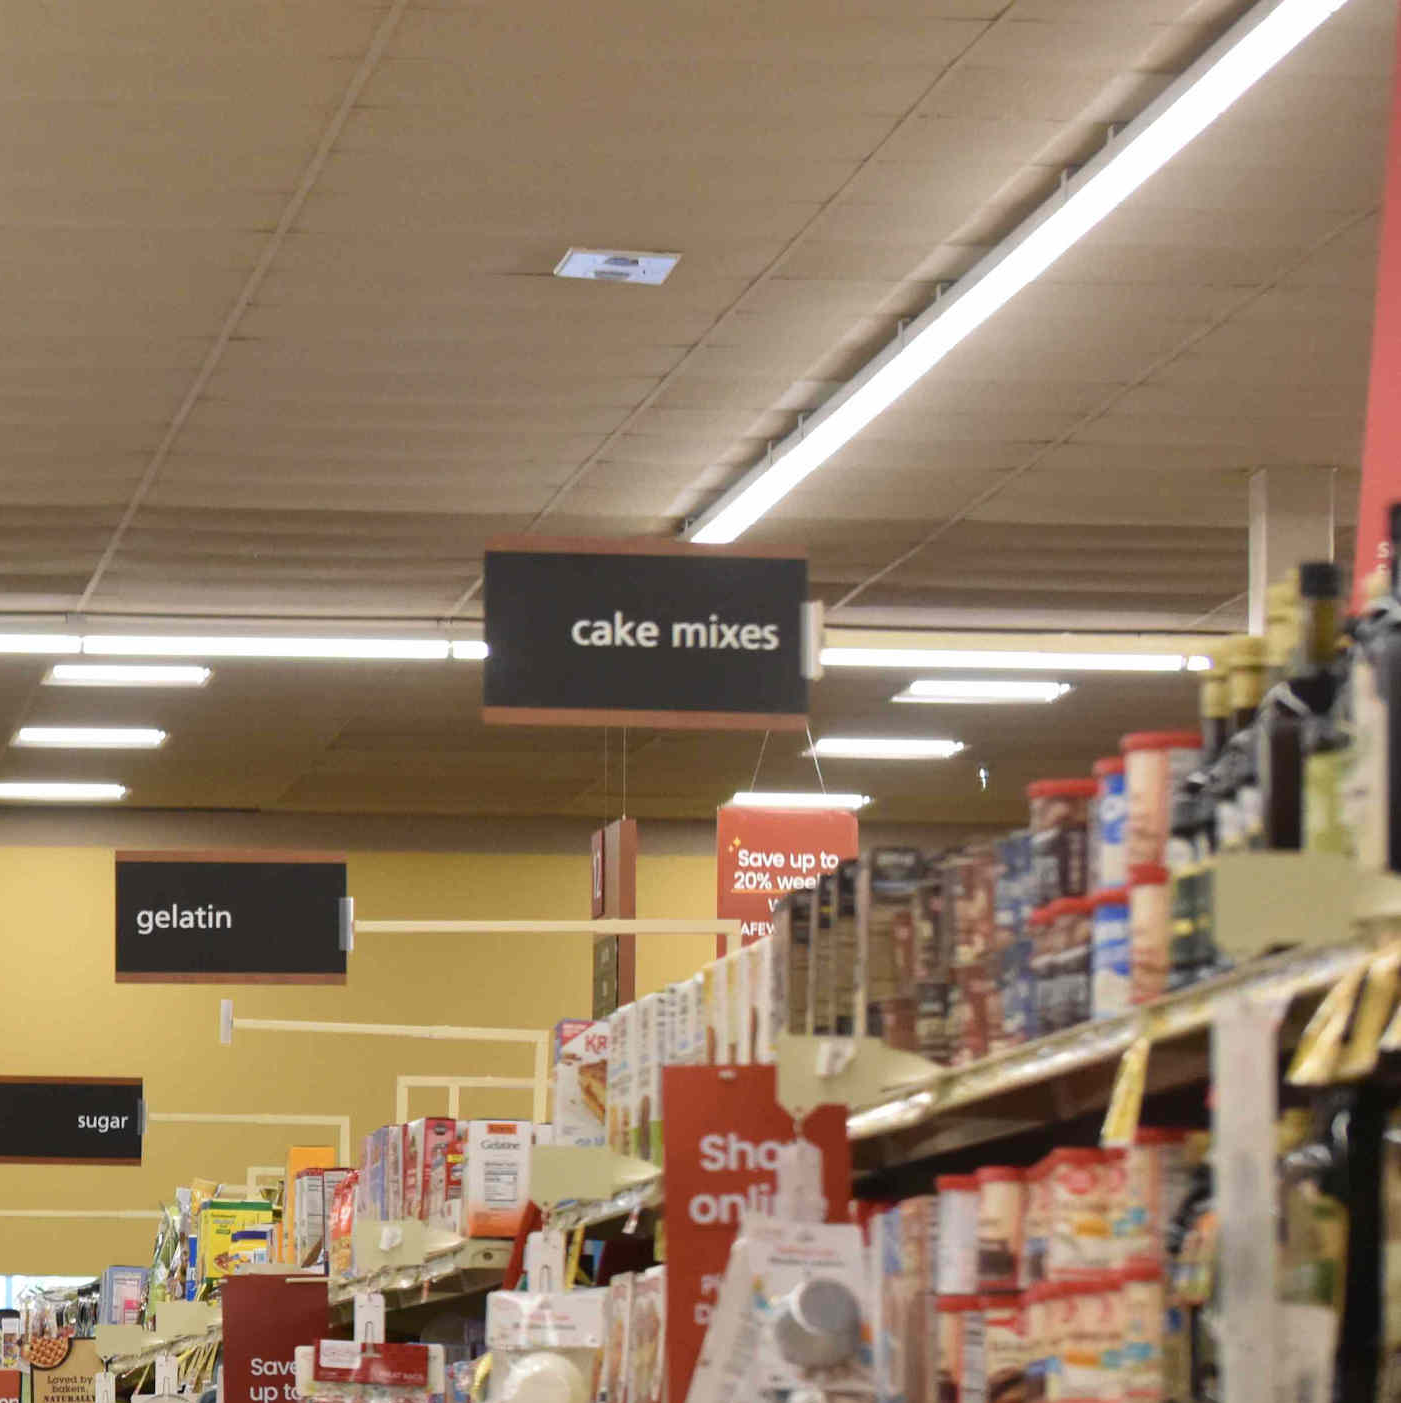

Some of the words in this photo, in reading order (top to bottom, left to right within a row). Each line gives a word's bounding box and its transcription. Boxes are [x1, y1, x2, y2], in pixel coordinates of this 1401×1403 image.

[570, 612, 661, 650] cake
[670, 614, 780, 652] mixes
[737, 848, 785, 868] Save
[790, 853, 816, 874] up
[820, 850, 839, 869] to
[733, 872, 772, 890] 20%
[136, 903, 233, 935] gelatin
[77, 1109, 130, 1134] sugar
[700, 1133, 797, 1175] Sho
[47, 1375, 78, 1385] Loved
[80, 1375, 94, 1386] by
